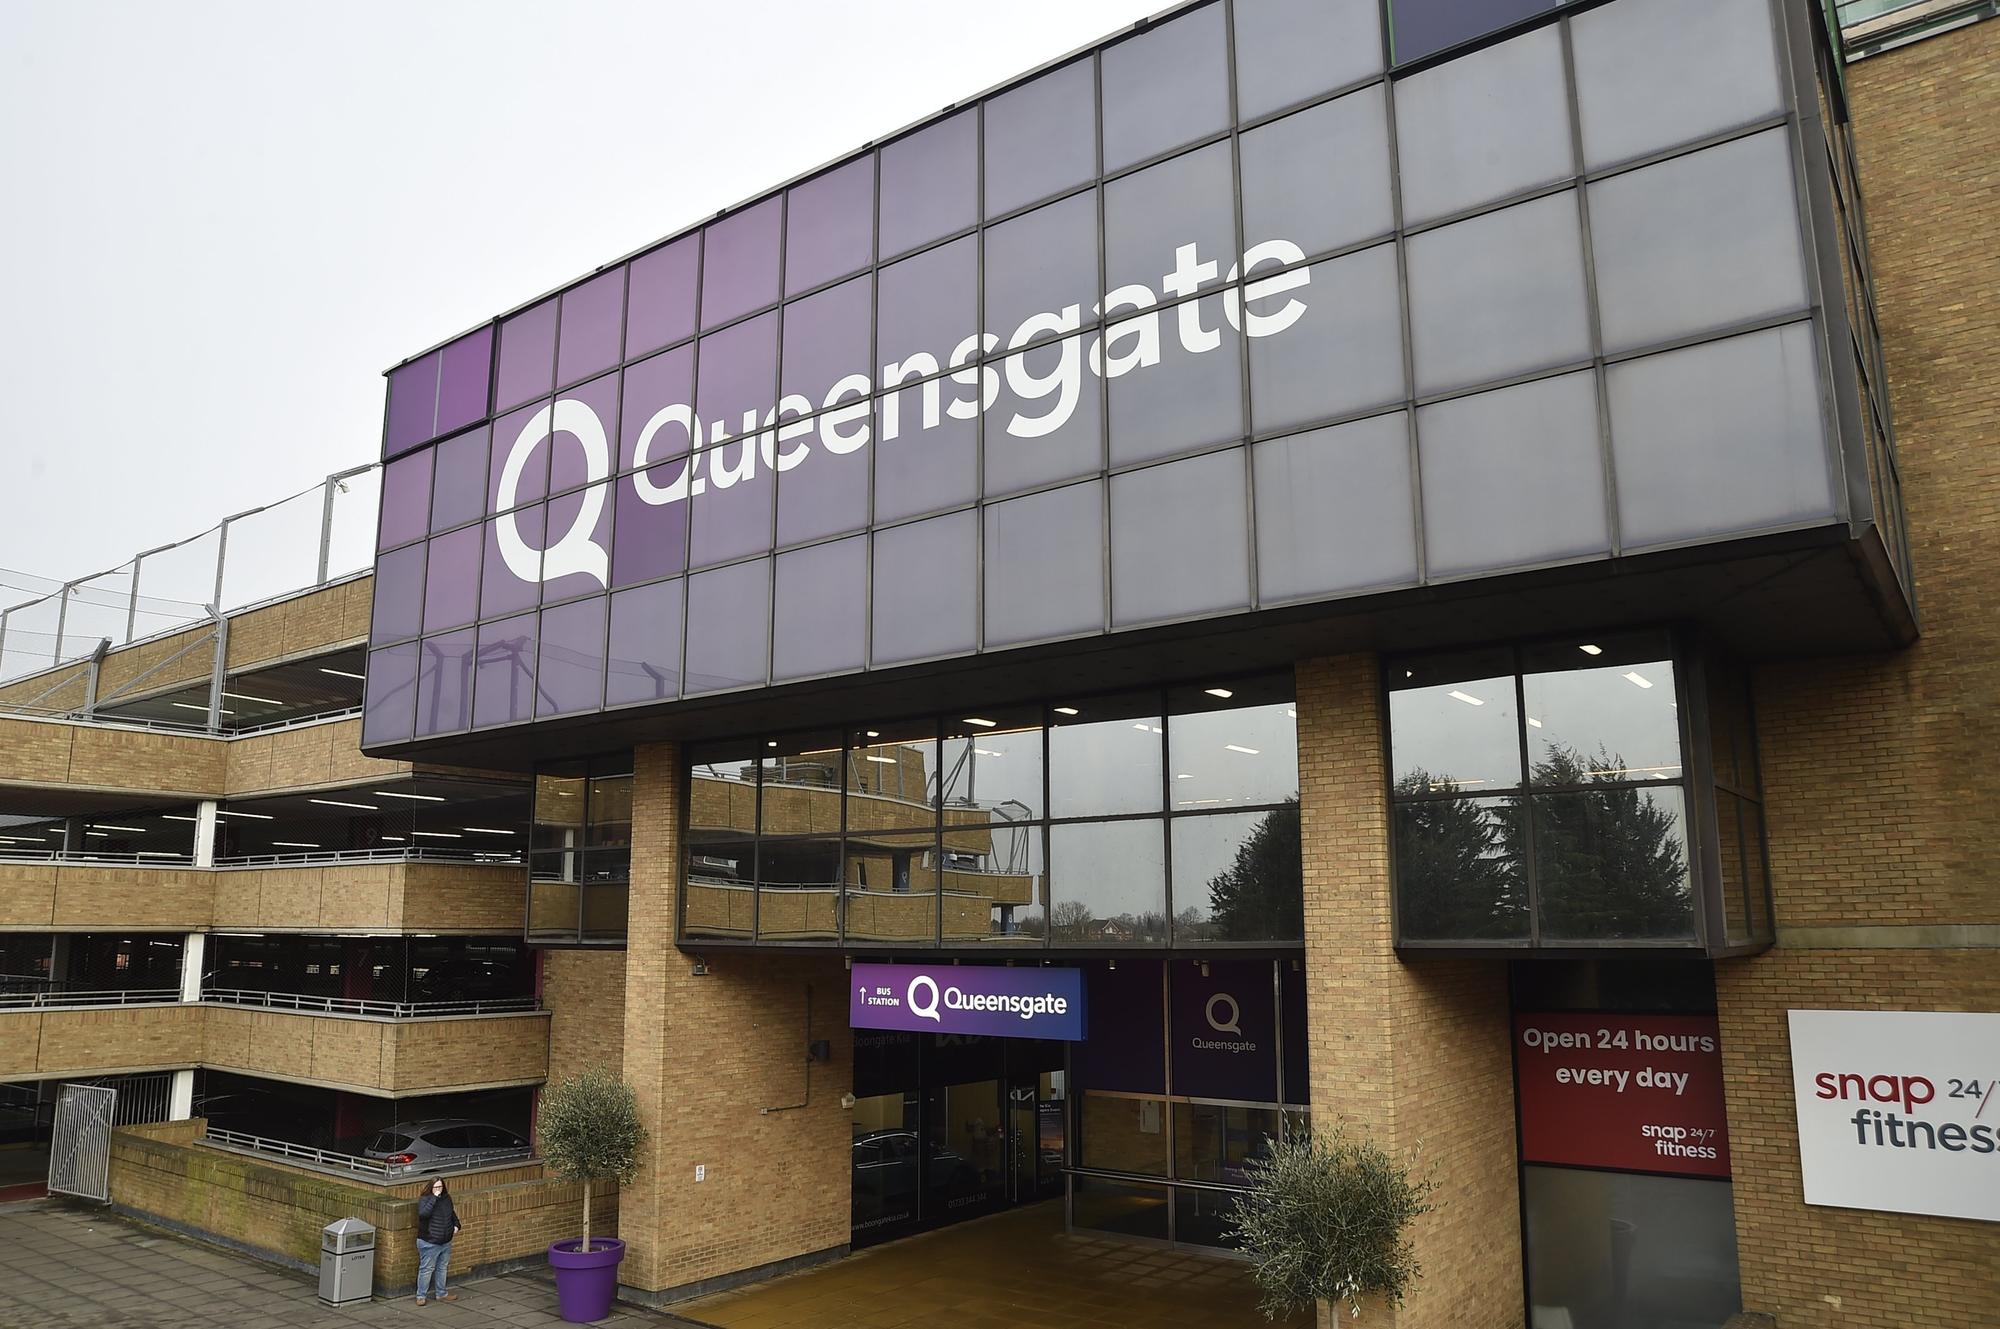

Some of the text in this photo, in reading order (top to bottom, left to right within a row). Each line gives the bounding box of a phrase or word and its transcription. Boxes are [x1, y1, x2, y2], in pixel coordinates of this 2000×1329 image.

[632, 238, 1312, 505] Queensgate
[867, 996, 900, 1006] STATION
[876, 987, 891, 996] BUS
[944, 986, 1068, 1019] Queensgate
[1192, 1037, 1257, 1054] Queensgate
[1523, 1028, 1715, 1054] Open 24 hours
[1555, 1066, 1689, 1095] every day
[1814, 1071, 2000, 1119] snap 24/
[1641, 1123, 1715, 1144] snap 24/7
[1850, 1108, 2000, 1154] fitnes
[1654, 1139, 1717, 1159] fitness
